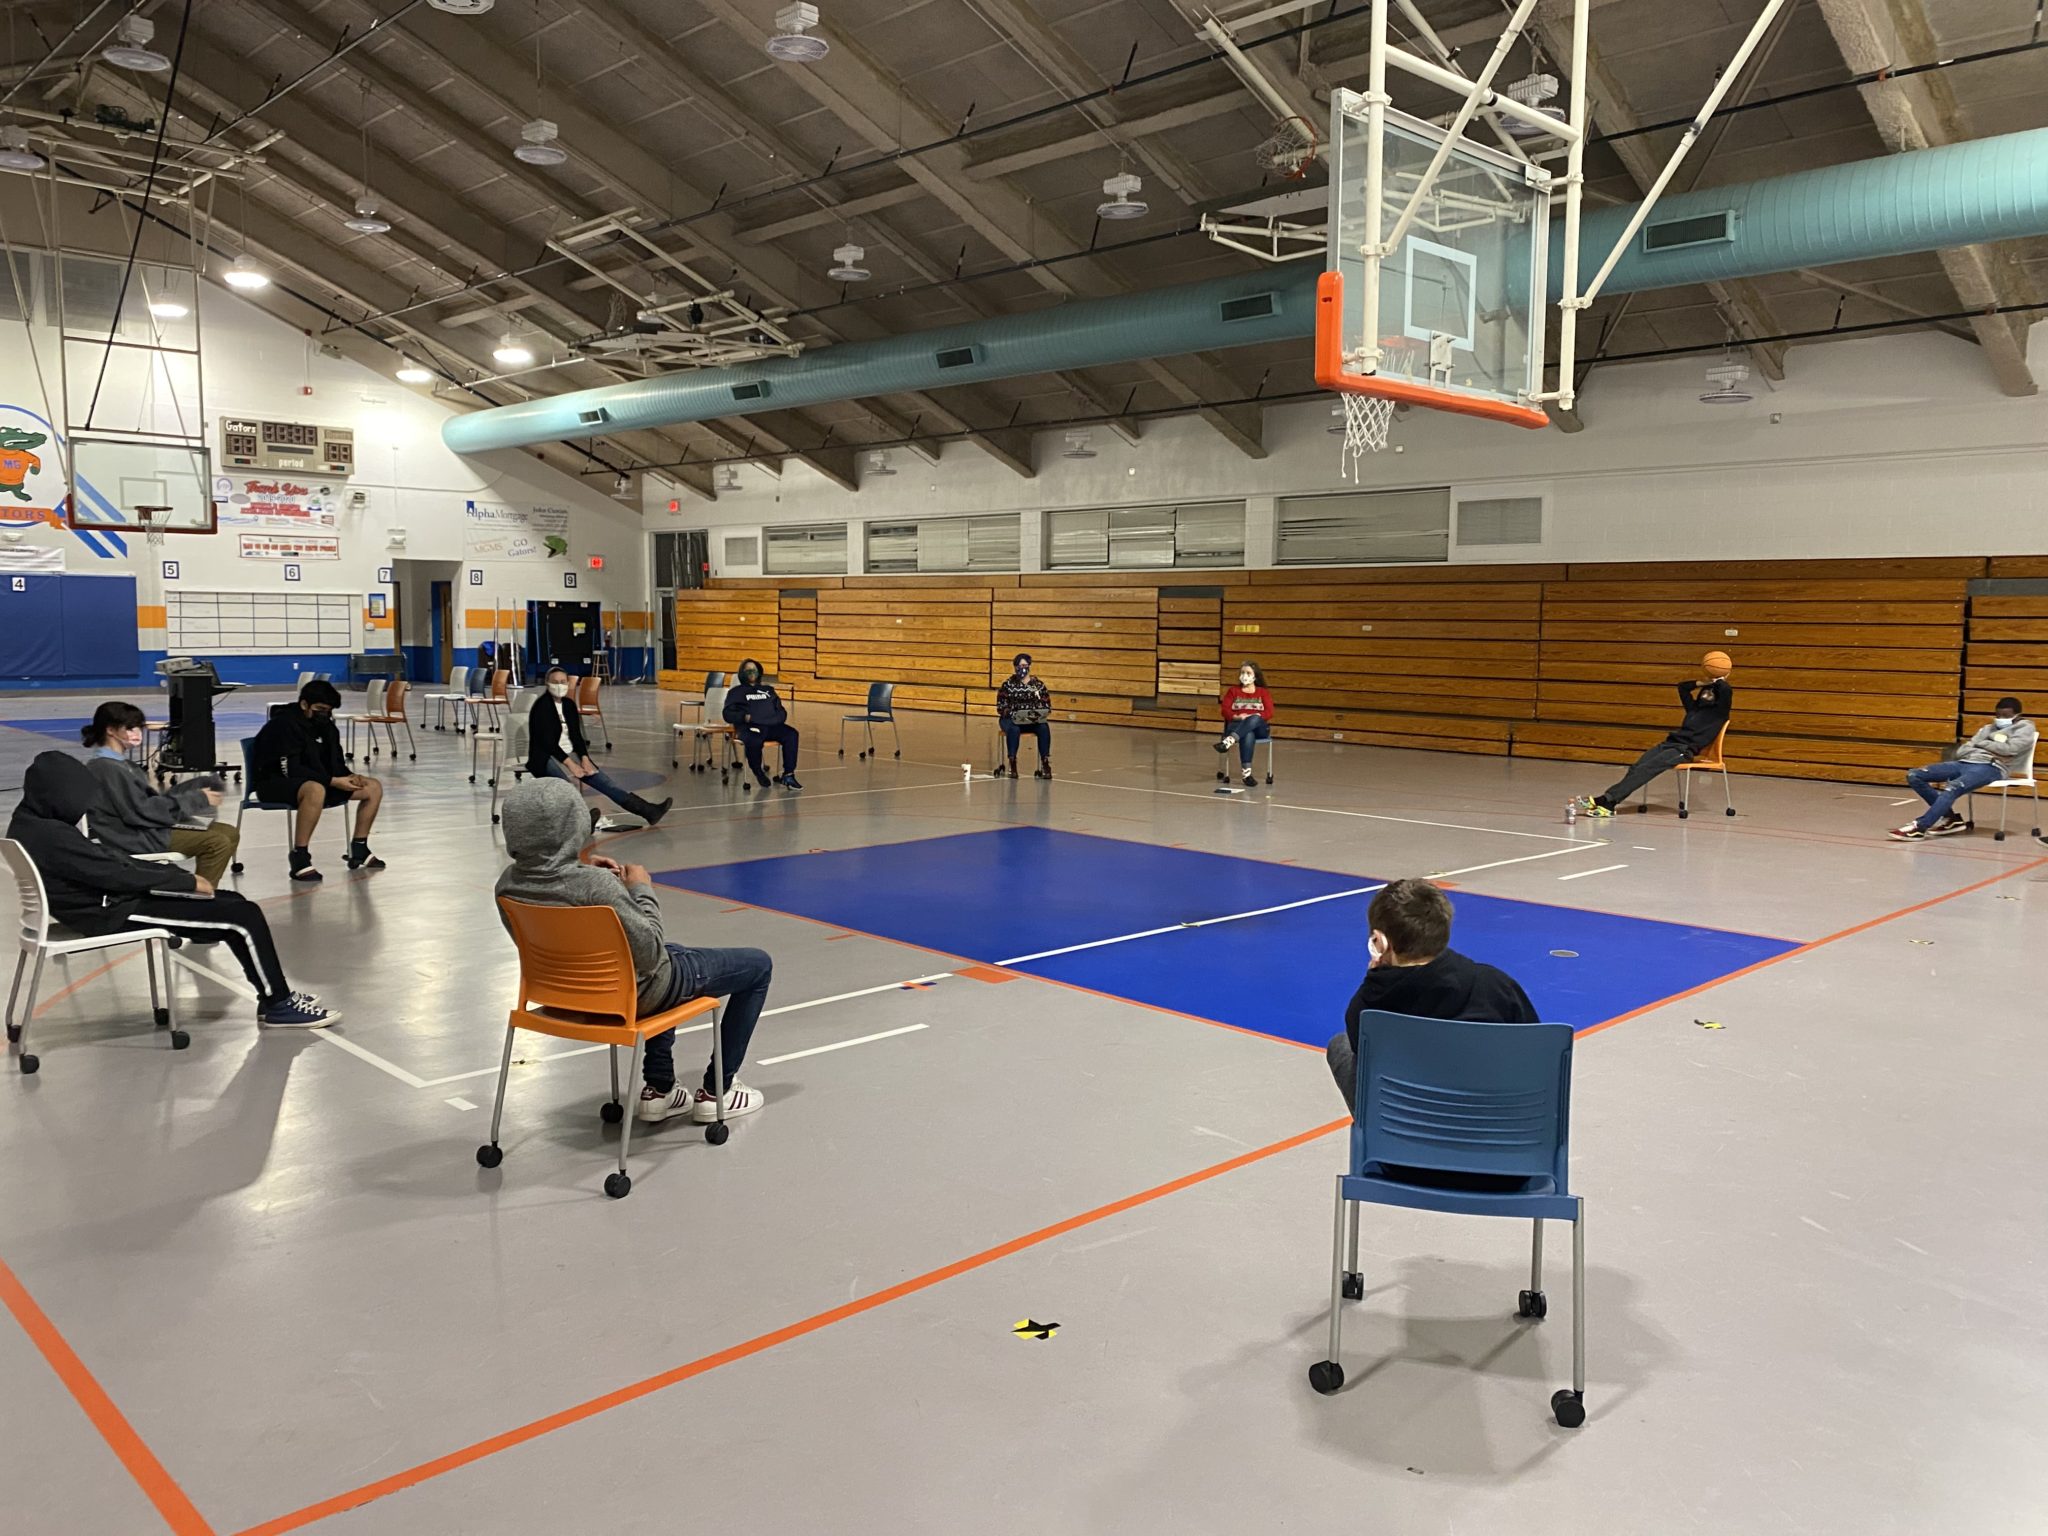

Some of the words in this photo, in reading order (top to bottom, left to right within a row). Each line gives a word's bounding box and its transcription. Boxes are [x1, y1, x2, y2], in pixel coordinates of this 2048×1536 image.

[225, 420, 256, 433] Gators
[278, 458, 304, 468] period
[244, 480, 279, 494] Thank
[281, 482, 309, 496] You
[513, 538, 528, 547] GO
[507, 546, 537, 557] Gators!
[167, 565, 175, 575] 5
[288, 568, 296, 578] 6
[381, 570, 389, 580] 7
[473, 572, 480, 582] 8
[567, 576, 574, 585] 9
[14, 579, 23, 589] 4
